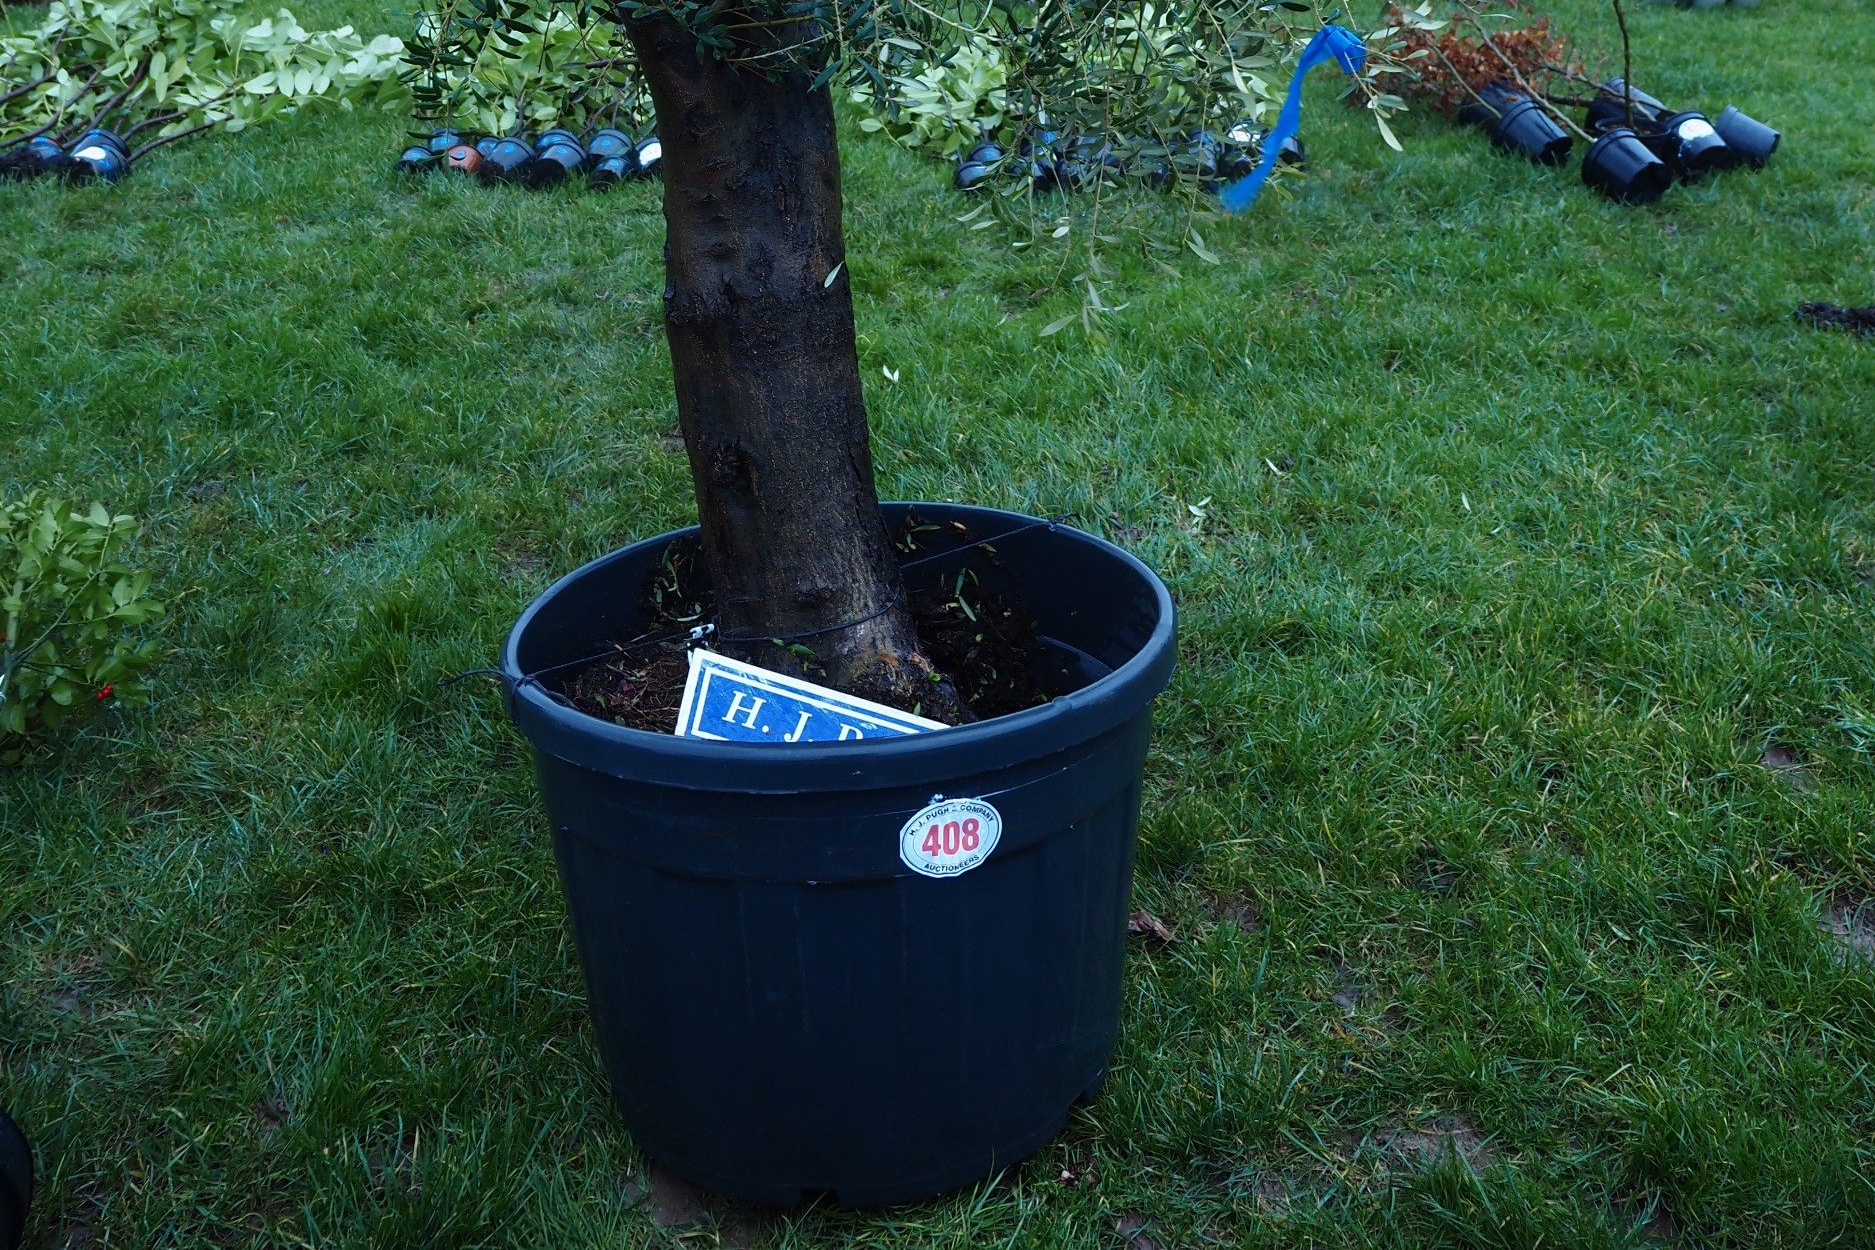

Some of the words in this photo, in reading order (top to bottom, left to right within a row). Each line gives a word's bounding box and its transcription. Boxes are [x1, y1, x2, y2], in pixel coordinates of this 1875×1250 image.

[721, 690, 770, 733] H.
[926, 807, 950, 821] PUGH
[959, 804, 995, 822] COMPANY
[921, 817, 980, 857] 408
[923, 854, 980, 873] AUCTIONEERS
